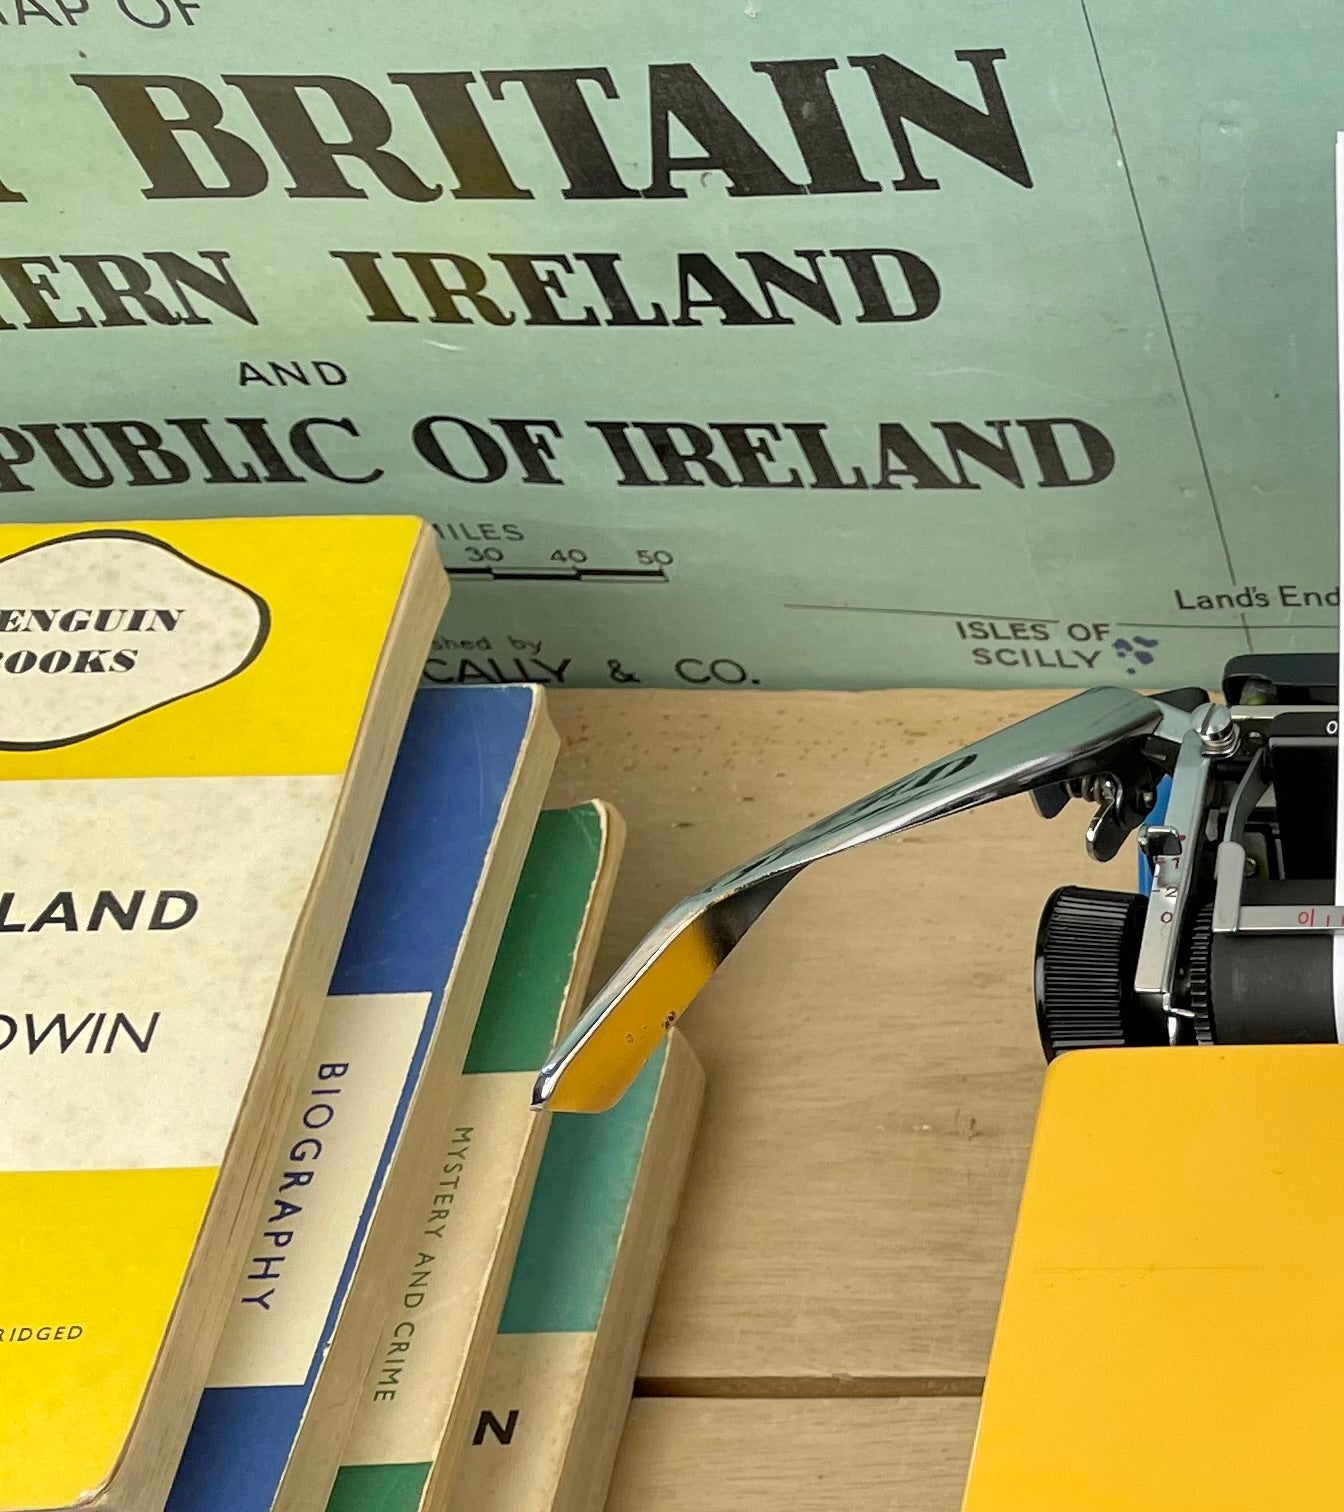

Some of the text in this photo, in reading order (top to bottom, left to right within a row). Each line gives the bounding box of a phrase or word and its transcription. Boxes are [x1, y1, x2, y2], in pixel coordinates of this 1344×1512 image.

[0, 0, 89, 26] AP
[70, 48, 1033, 202] BRITAIN
[0, 249, 942, 330] ERN IRELAND
[238, 360, 347, 386] AND
[410, 414, 565, 488] OF
[587, 418, 1115, 490] IRELAND
[465, 547, 674, 566] 30 40 50
[1174, 585, 1340, 610] Land's End
[955, 620, 1110, 642] ISLES OF
[0, 650, 139, 673] OOKS
[607, 658, 641, 684] &
[675, 658, 760, 685] CO.
[972, 647, 1102, 670] SCILLY
[0, 890, 199, 932] LAND
[241, 1062, 350, 1311] BIOGRAPHY
[373, 1126, 475, 1404] MYSTERY AND CRIME
